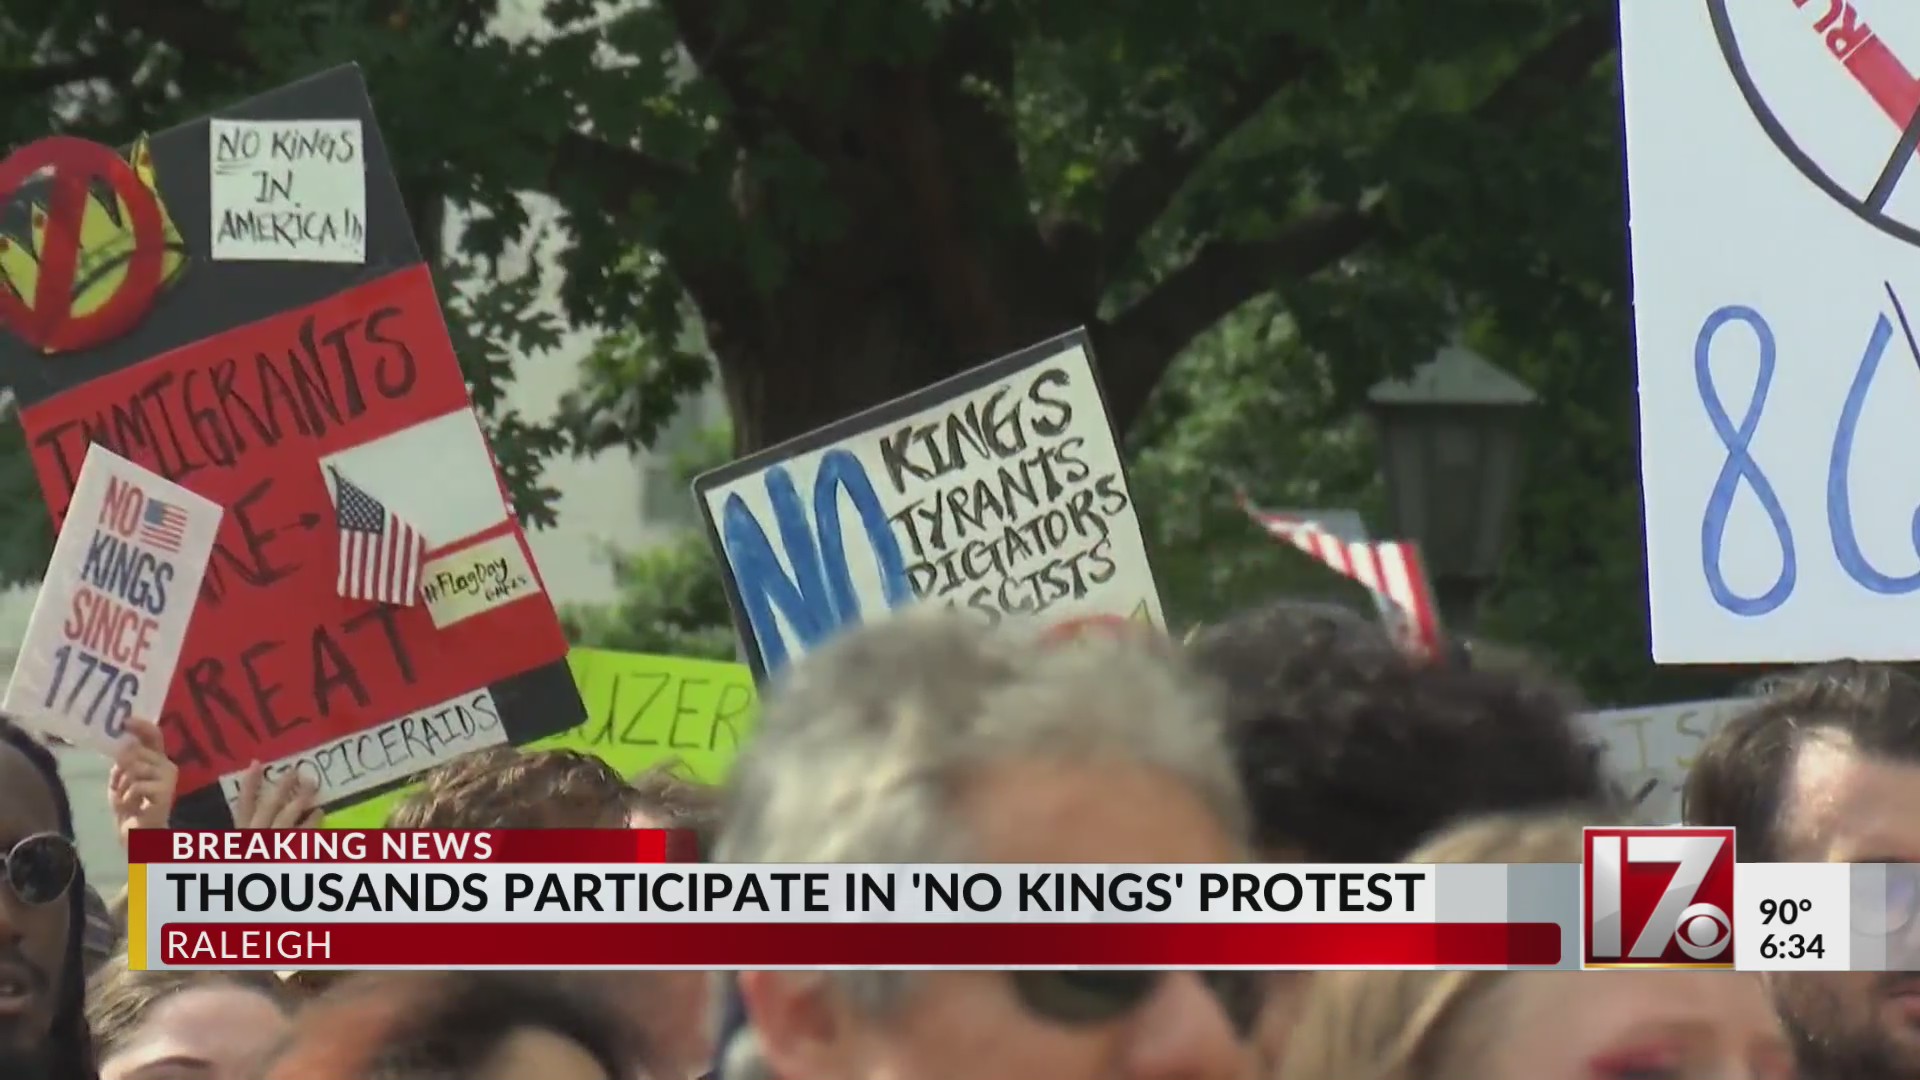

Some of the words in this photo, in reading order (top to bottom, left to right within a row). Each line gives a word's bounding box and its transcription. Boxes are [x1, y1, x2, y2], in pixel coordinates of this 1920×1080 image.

[217, 127, 260, 162] NO
[252, 169, 293, 203] IN
[880, 368, 1073, 492] KINGS
[99, 475, 144, 538] NO
[888, 437, 1090, 557] TYRANTS
[906, 473, 1128, 598] DICTATORS
[81, 529, 174, 616] KINGS
[723, 448, 914, 676] NO
[944, 535, 1117, 632] SCISTS
[64, 588, 159, 672] SINCE
[44, 644, 139, 738] 1776
